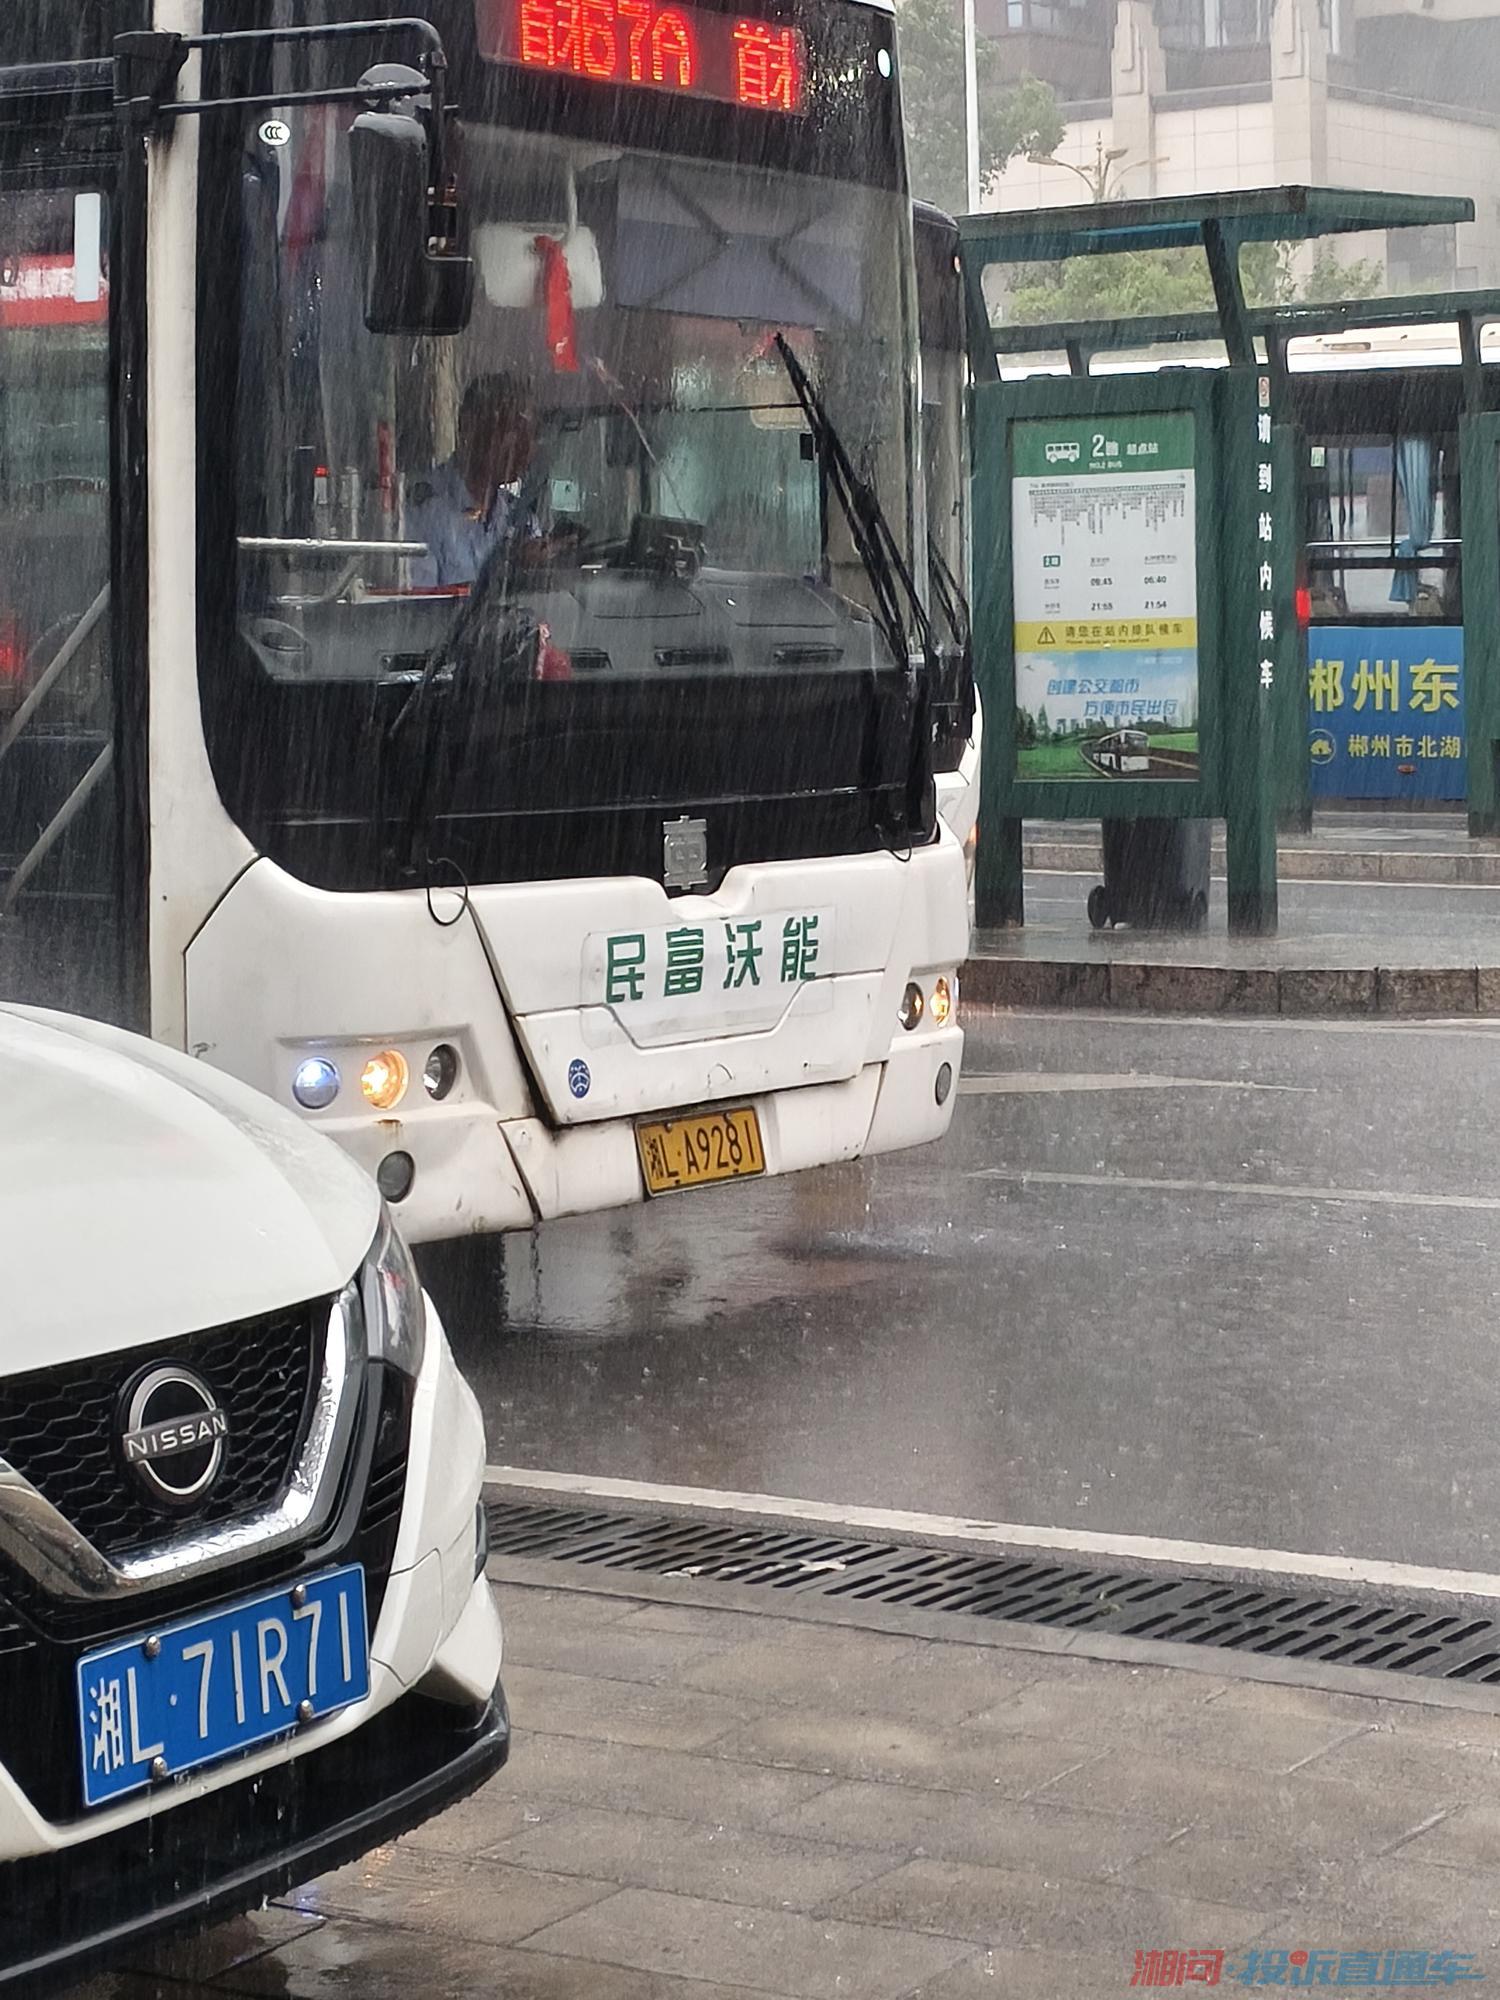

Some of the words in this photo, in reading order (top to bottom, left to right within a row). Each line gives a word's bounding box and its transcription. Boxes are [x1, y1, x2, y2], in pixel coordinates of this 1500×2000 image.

[1257, 413, 1274, 689] 请到站内候车
[1047, 678, 1140, 696] 创建公交都市
[1084, 699, 1178, 717] 方便市民出行
[1348, 734, 1461, 759] 郴州市北湖
[606, 915, 819, 1003] 民富沃能
[128, 1412, 226, 1459] NISSAN
